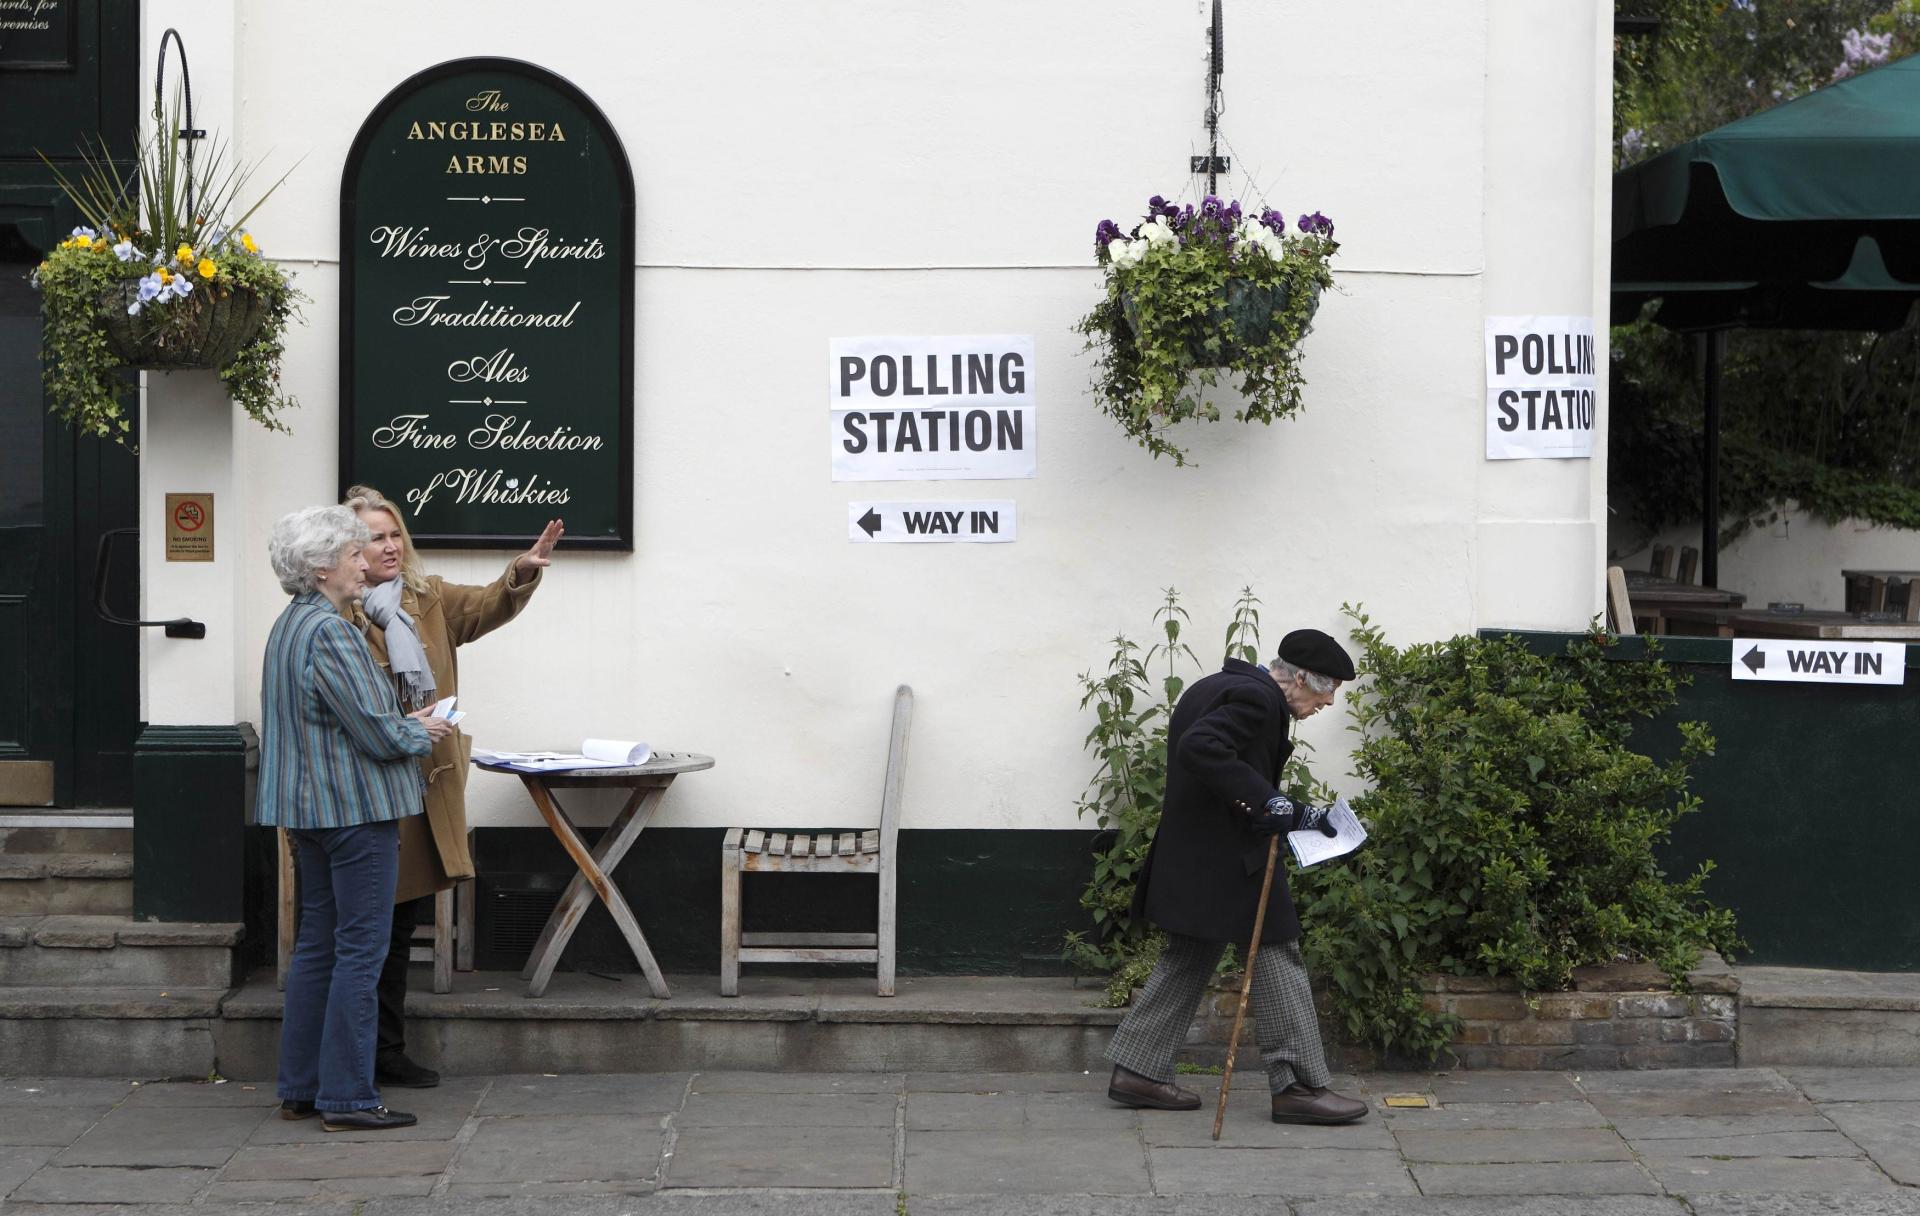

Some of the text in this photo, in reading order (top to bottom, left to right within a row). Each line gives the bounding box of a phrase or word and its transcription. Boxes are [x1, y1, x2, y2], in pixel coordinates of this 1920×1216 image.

[0, 0, 58, 16] irits, for
[465, 90, 510, 112] The
[407, 121, 566, 142] ANGLESEA
[446, 155, 528, 175] ARMS
[370, 225, 606, 270] Wines & Spirits
[392, 295, 582, 328] Traditional
[447, 348, 530, 383] Ales
[840, 352, 1026, 398] POLLING
[372, 413, 604, 451] Fine Selection
[843, 409, 1024, 455] STATION
[405, 468, 571, 516] of Whiskies
[902, 510, 999, 534] WAY IN
[1786, 649, 1883, 676] WAY IN
